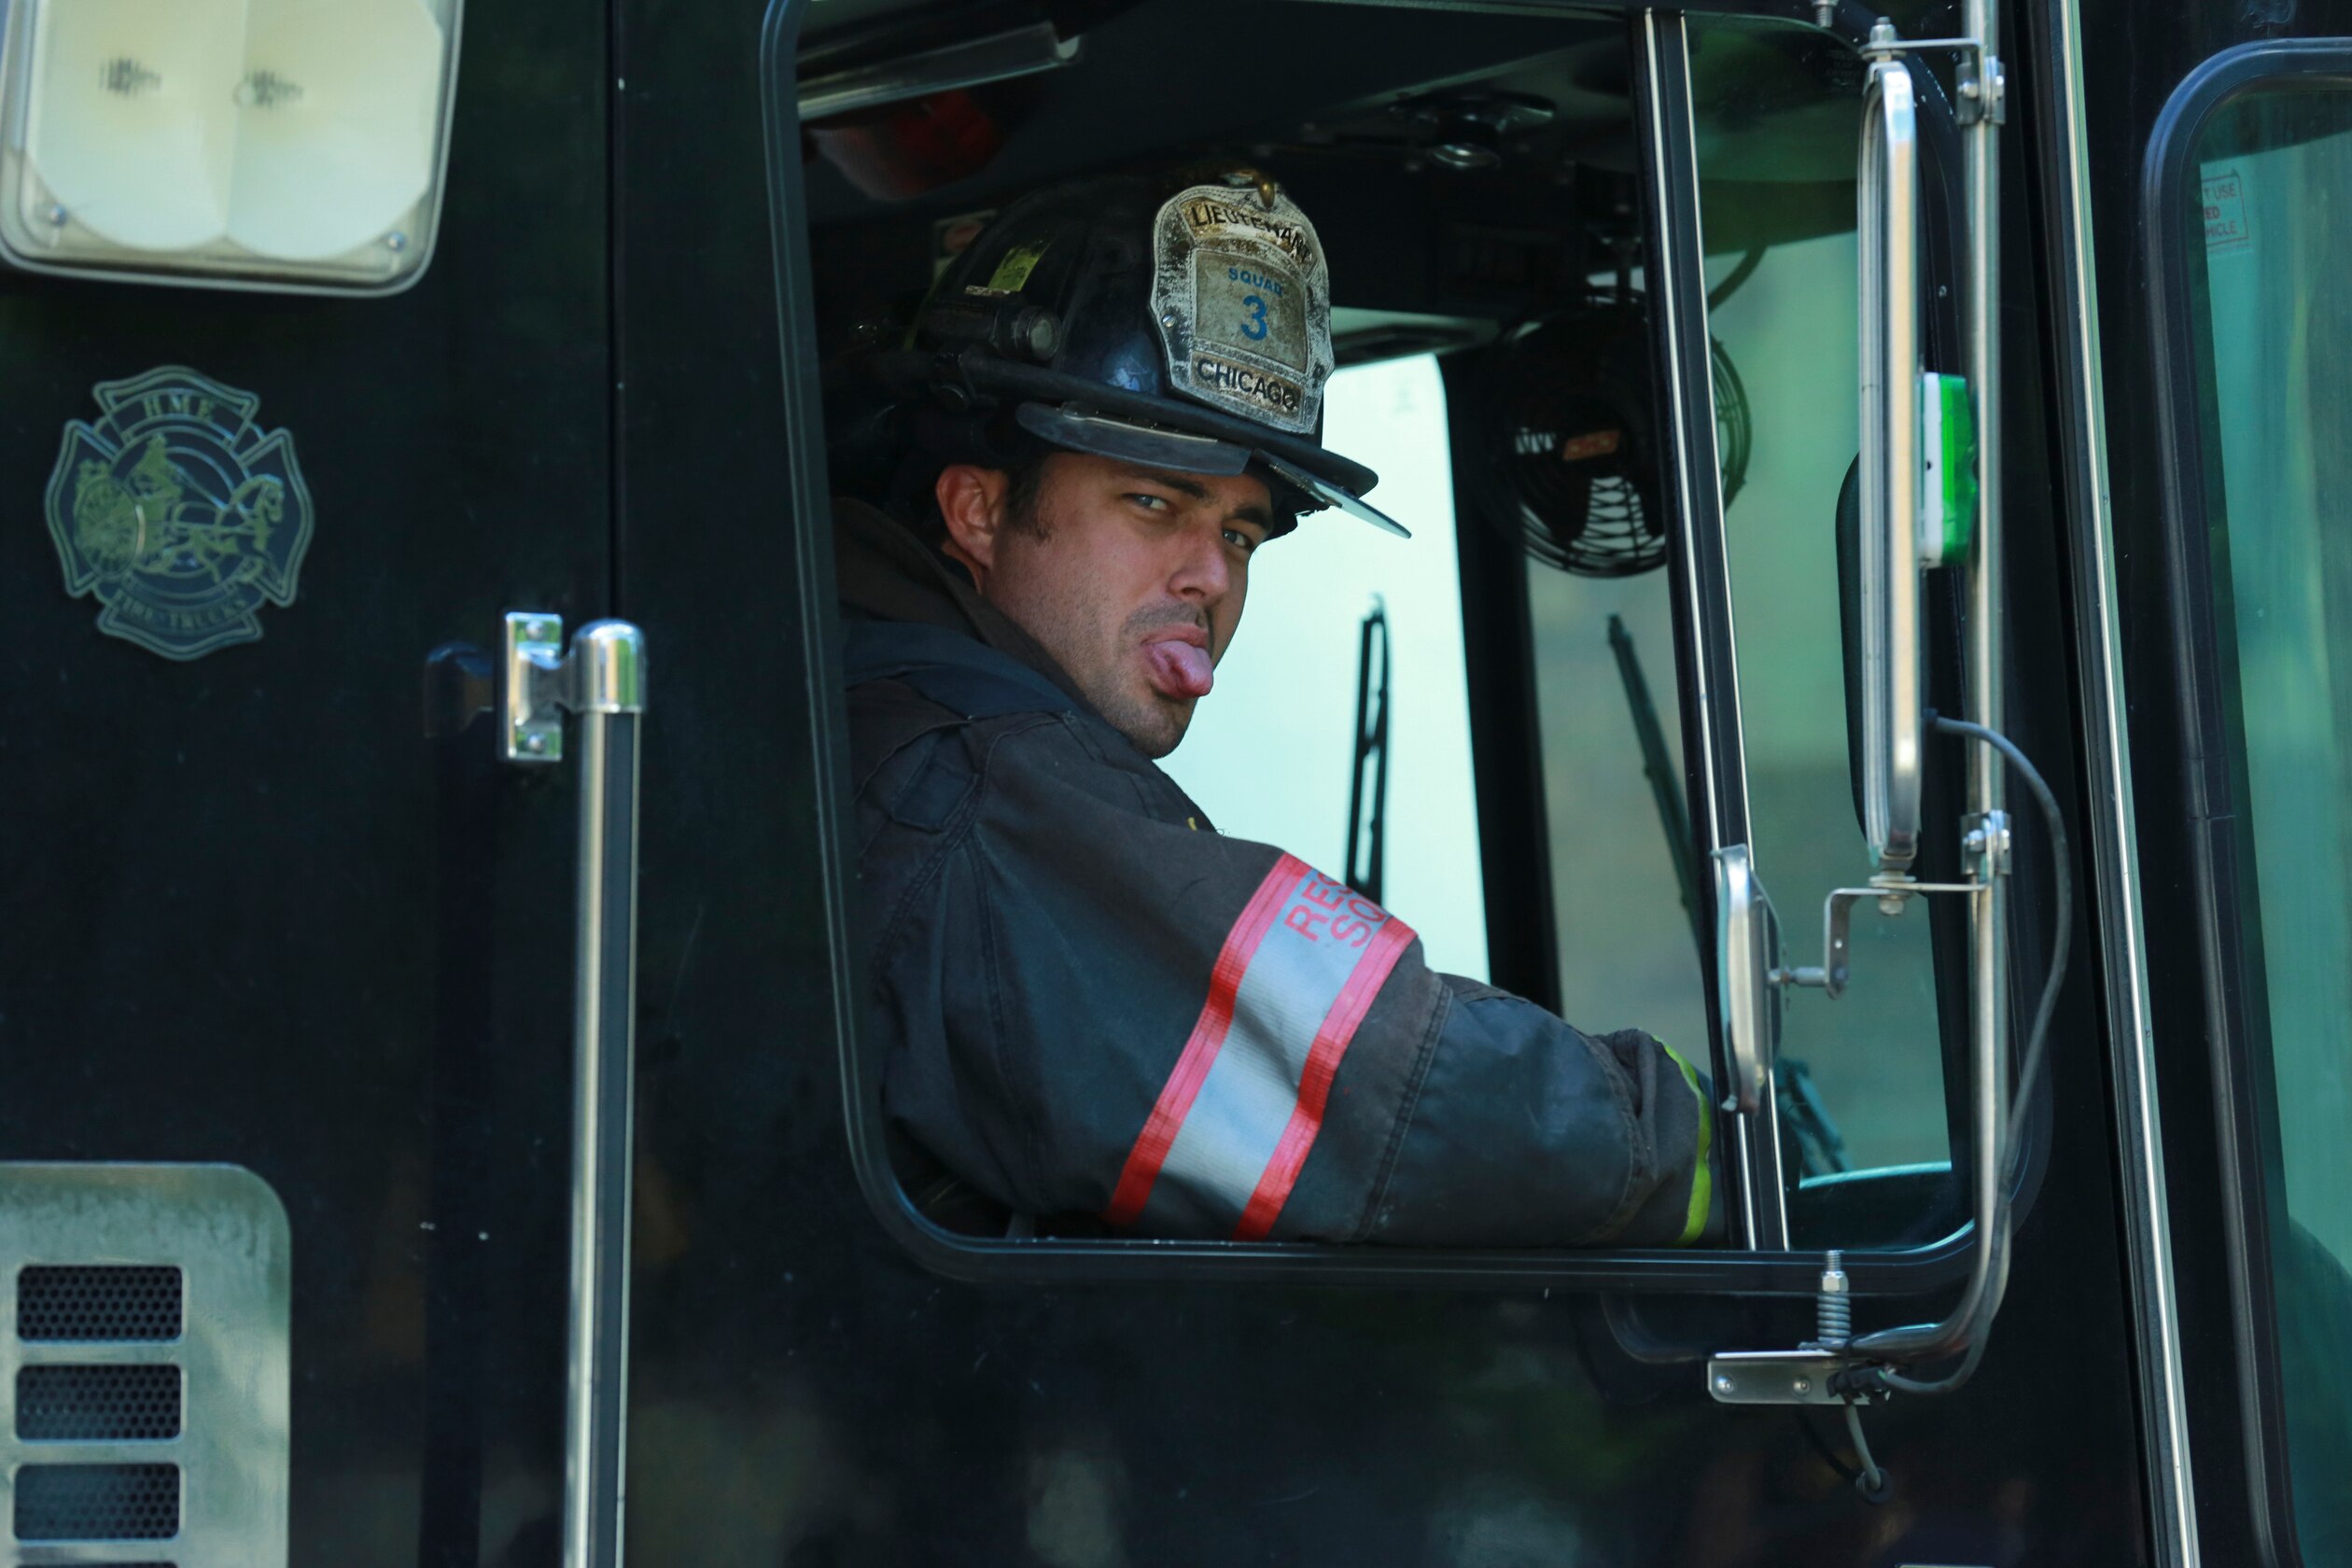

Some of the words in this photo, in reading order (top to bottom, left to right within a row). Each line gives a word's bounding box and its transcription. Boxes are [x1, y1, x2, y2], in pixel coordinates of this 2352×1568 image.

[1191, 204, 1311, 262] LIEUTENANT
[1228, 268, 1283, 297] SQUAD
[1240, 295, 1268, 342] 3
[1197, 358, 1296, 411] CHICAGO
